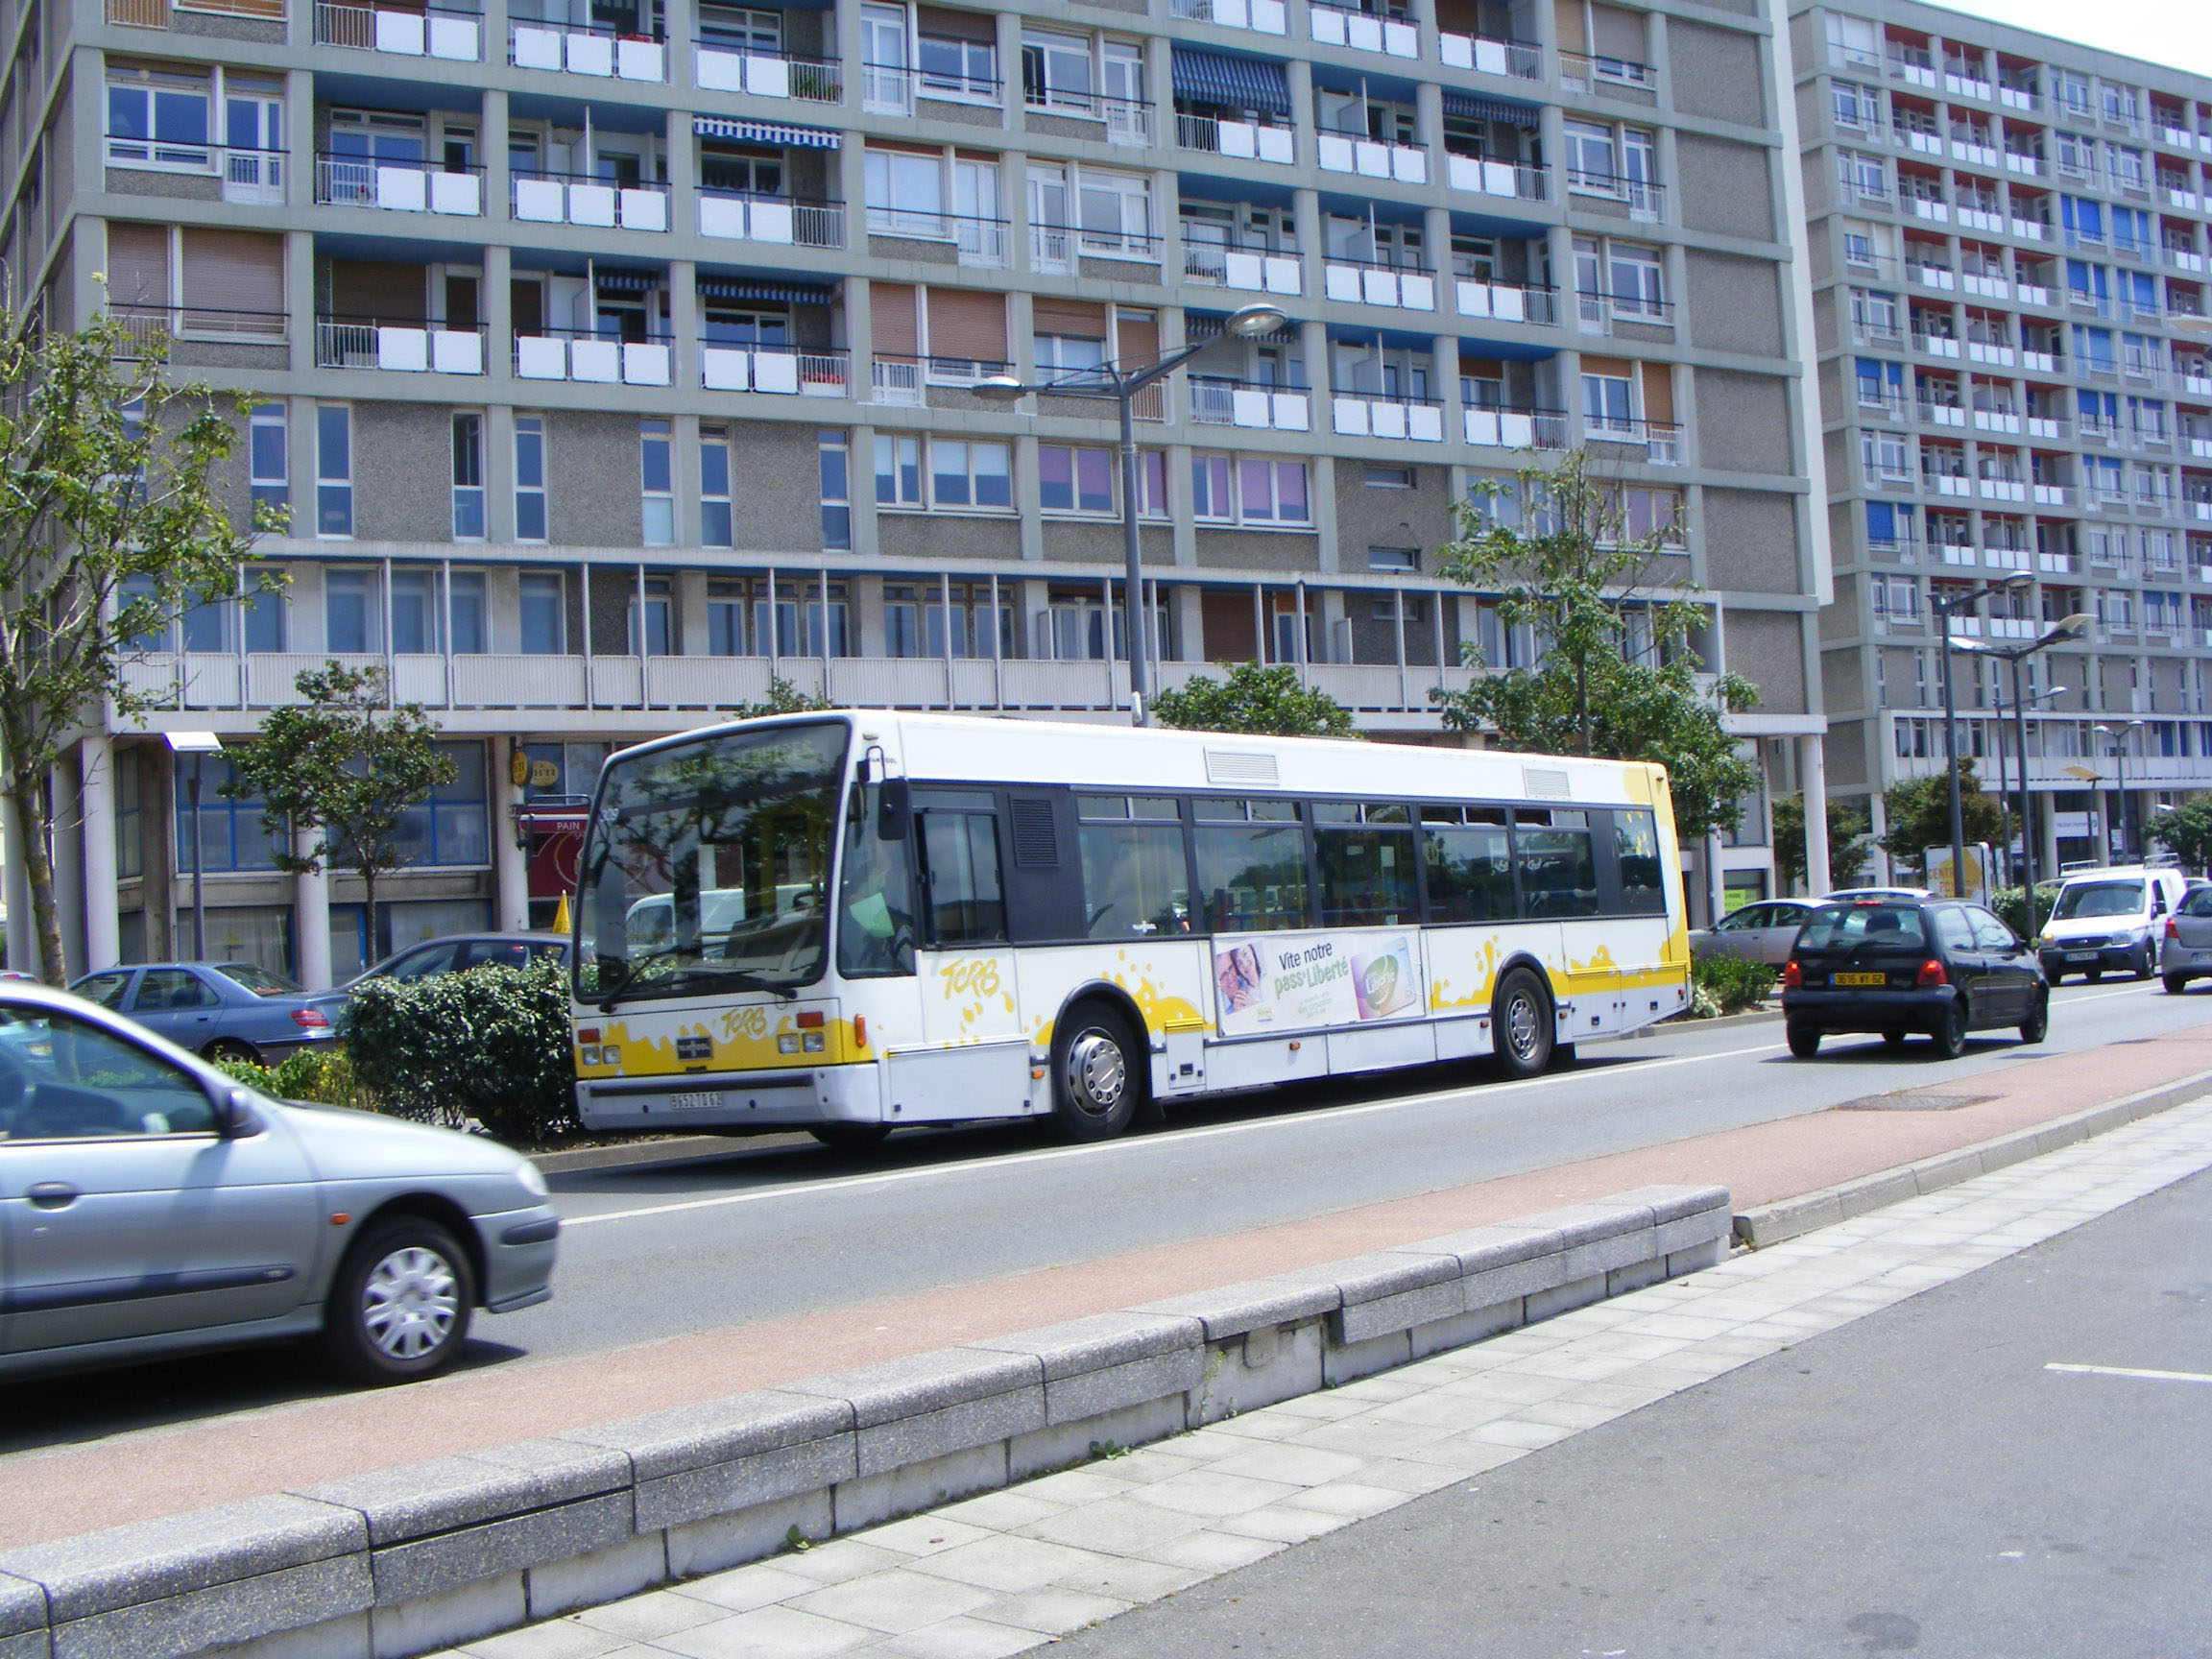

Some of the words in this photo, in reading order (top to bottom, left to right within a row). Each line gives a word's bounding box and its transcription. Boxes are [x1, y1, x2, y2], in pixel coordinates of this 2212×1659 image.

[557, 822, 580, 830] PAIN
[1279, 950, 1301, 971] Vite
[1304, 943, 1333, 964] notre
